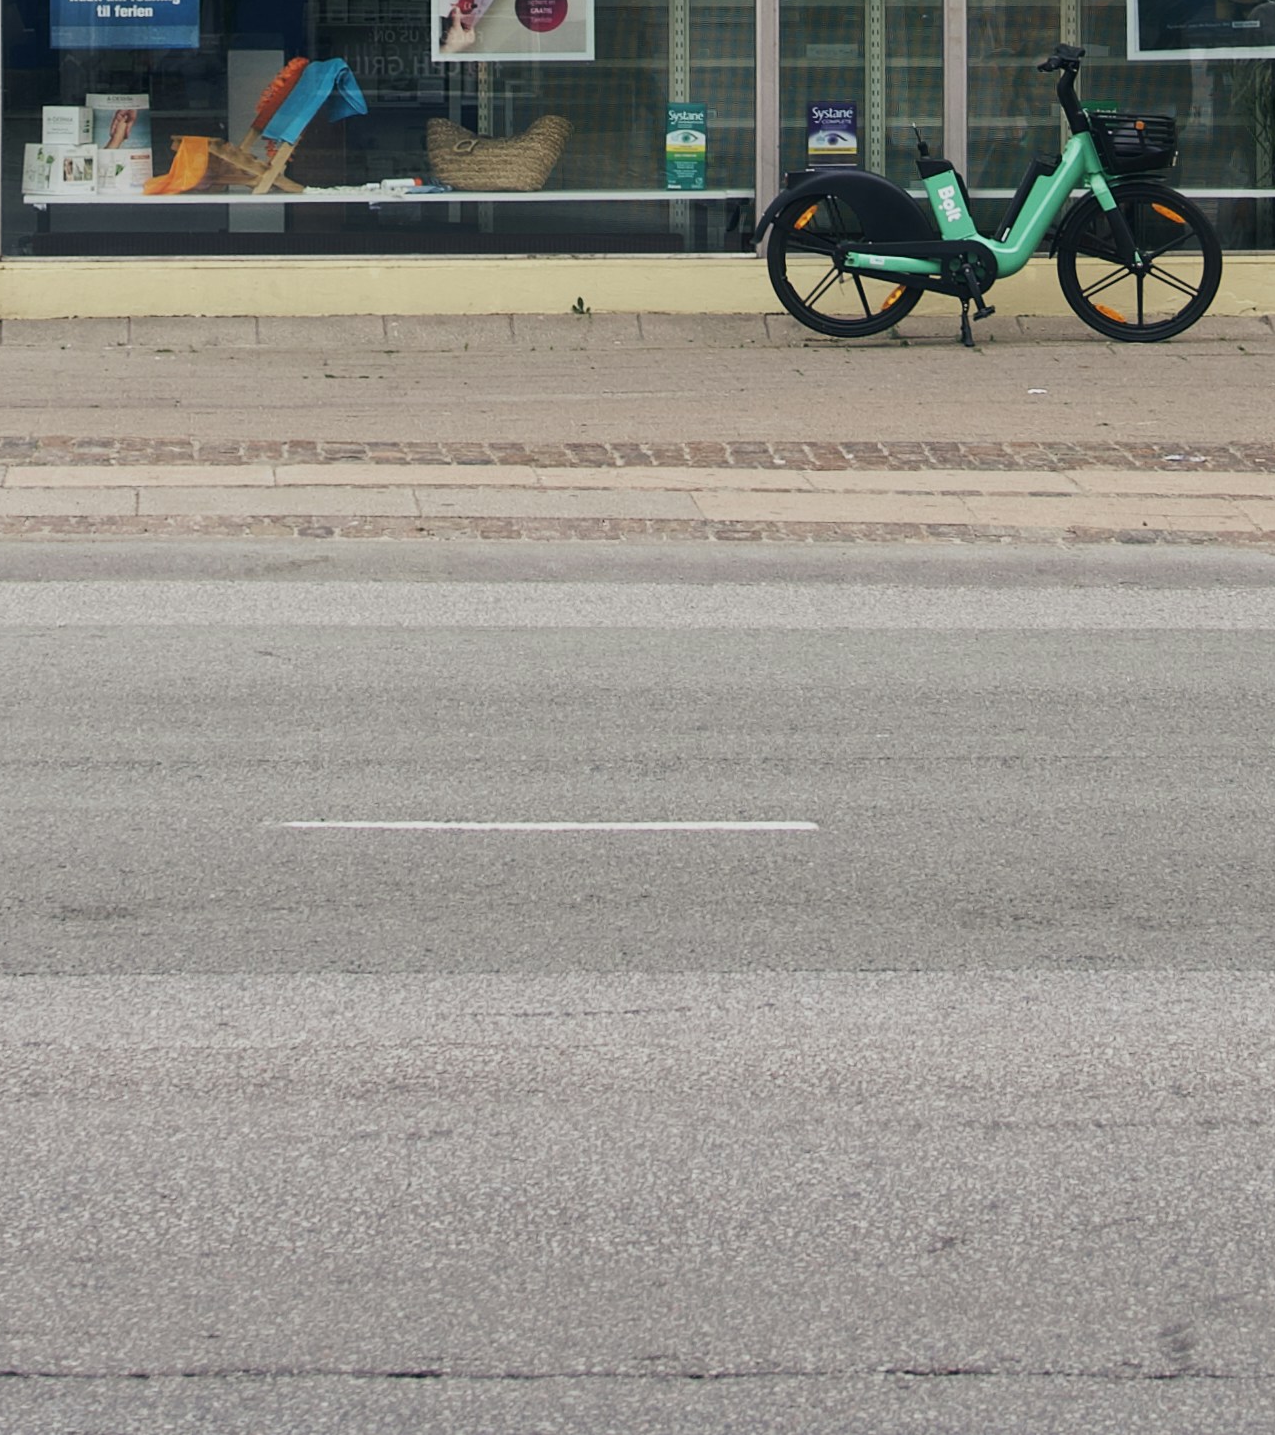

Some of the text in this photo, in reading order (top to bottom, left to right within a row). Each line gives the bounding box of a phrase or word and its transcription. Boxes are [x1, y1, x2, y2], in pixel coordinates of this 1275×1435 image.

[97, 5, 153, 17] til ferien
[812, 107, 854, 124] Systane
[937, 184, 962, 223] Bolt
